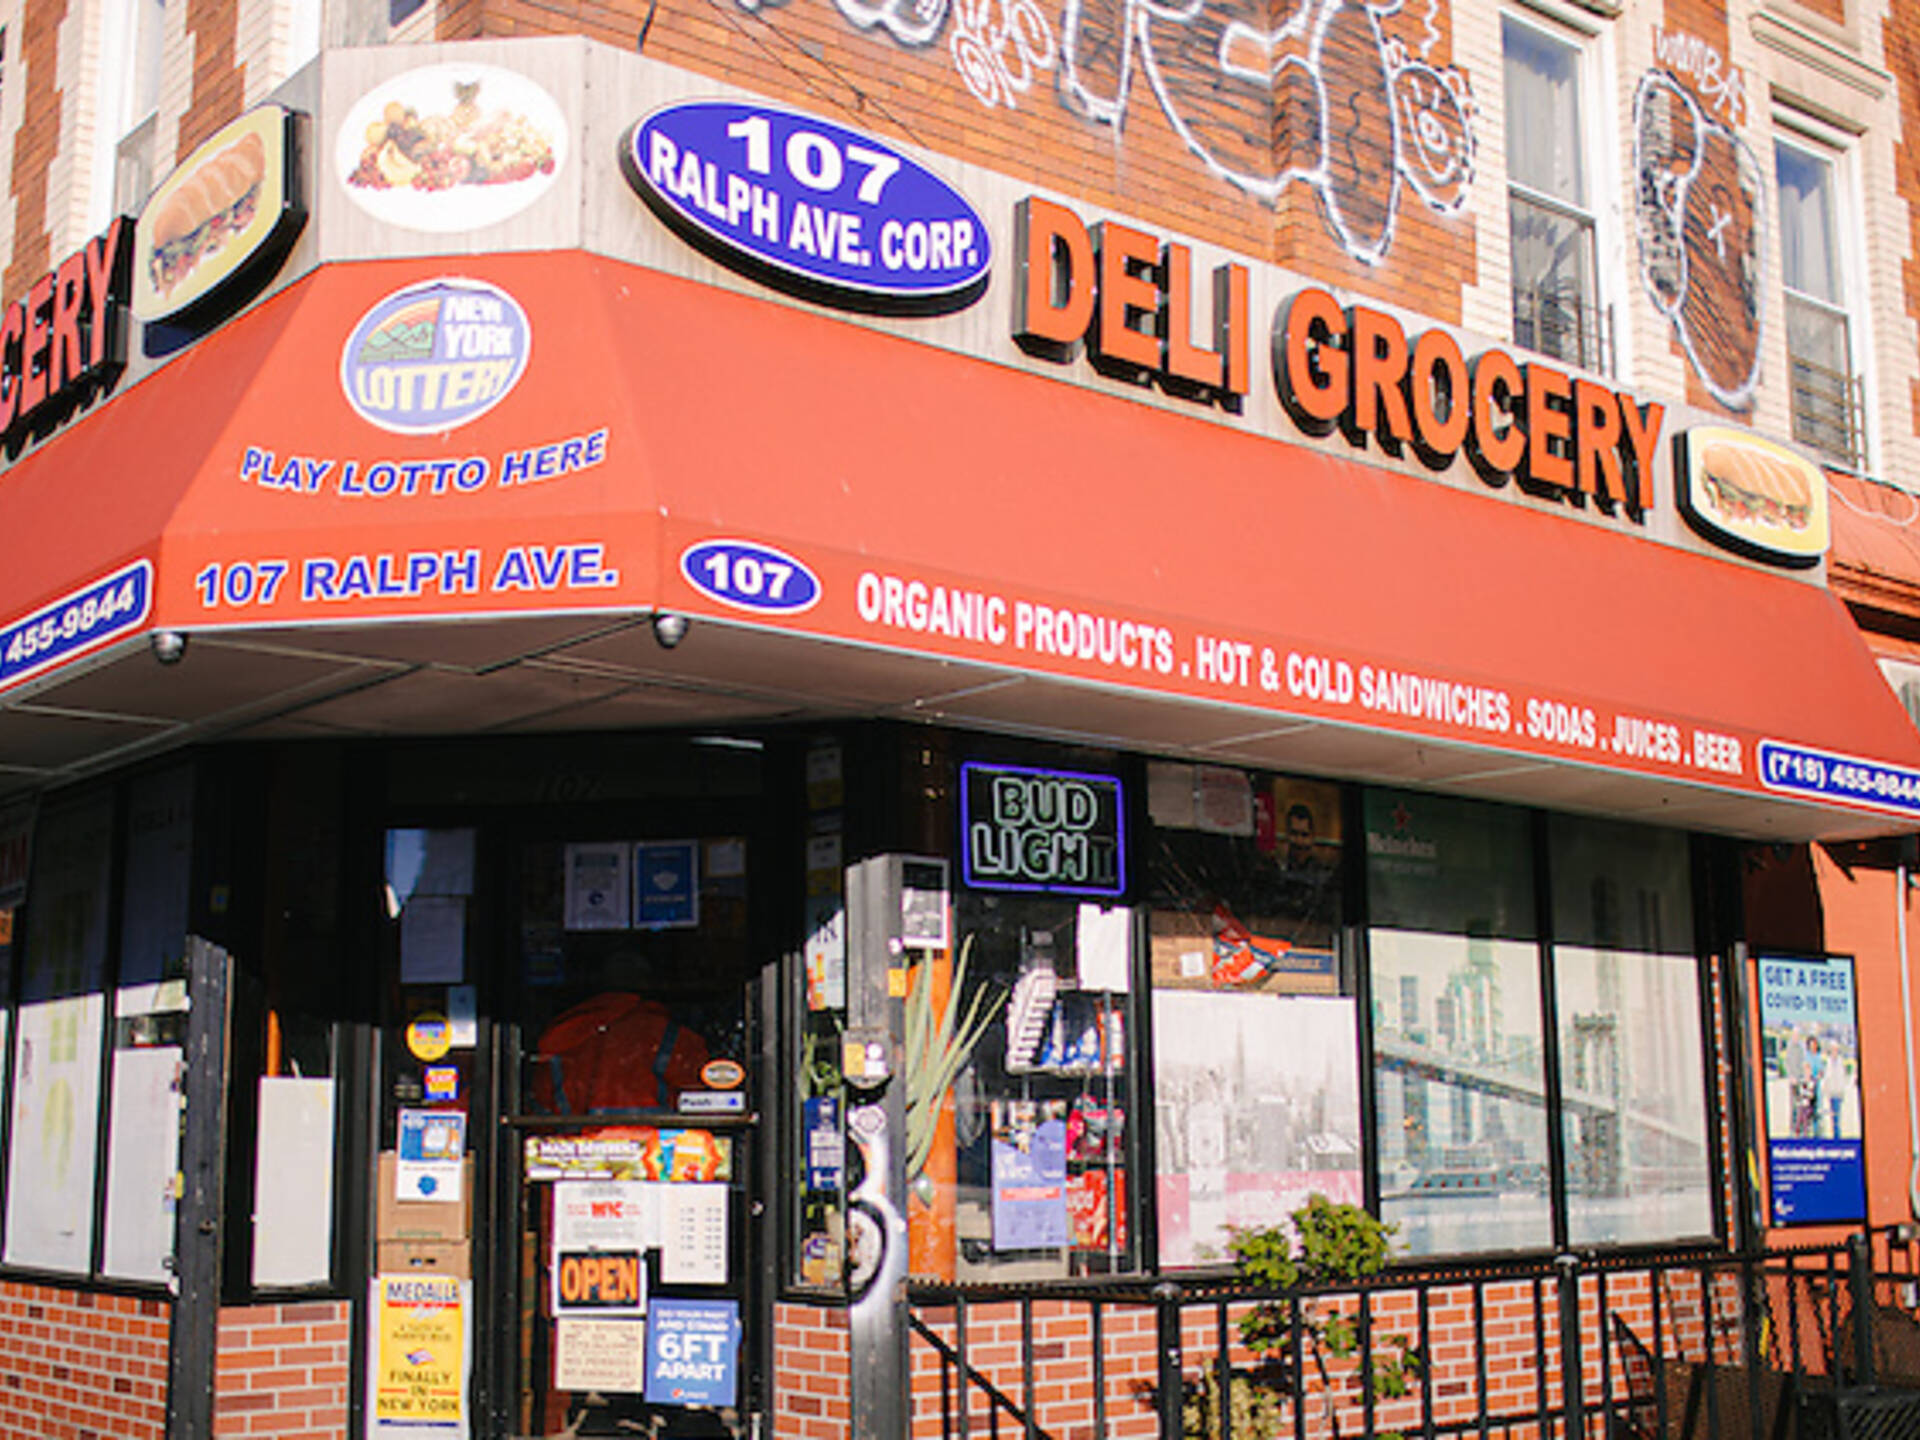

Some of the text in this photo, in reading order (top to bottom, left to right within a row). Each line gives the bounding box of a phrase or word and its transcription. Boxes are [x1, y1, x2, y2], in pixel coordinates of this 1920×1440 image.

[727, 116, 900, 205] 107
[650, 129, 978, 271] RALPH AVE. CORP.
[443, 296, 504, 323] NEW
[444, 322, 514, 359] YORK
[1020, 194, 1666, 509] DELI GROCERY
[355, 358, 517, 411] LOTTERY
[242, 429, 608, 495] PLAY LOTTO HERE
[196, 544, 619, 609] 107 RALPH AVE.
[703, 553, 795, 600] 107
[5, 578, 136, 663] 455-9844
[856, 572, 1007, 645] ORGANIC
[1014, 601, 1174, 674] PRODUCTS
[1196, 635, 1253, 687] HOT
[1259, 647, 1280, 692] &
[1286, 652, 1354, 704] COLD
[1358, 665, 1511, 732] SANDWICHES
[1526, 698, 1597, 748] SODAS
[1611, 715, 1681, 763] JUICES
[1693, 729, 1743, 775] BEER
[1768, 748, 1827, 790] (718)
[993, 777, 1099, 831] BUD
[1765, 965, 1846, 991] GET A FREE
[560, 1257, 638, 1301] OPEN
[656, 1360, 726, 1381] APART
[657, 1333, 729, 1362] 6FT
[389, 1370, 451, 1385] FINALLY
[411, 1384, 427, 1396] IN
